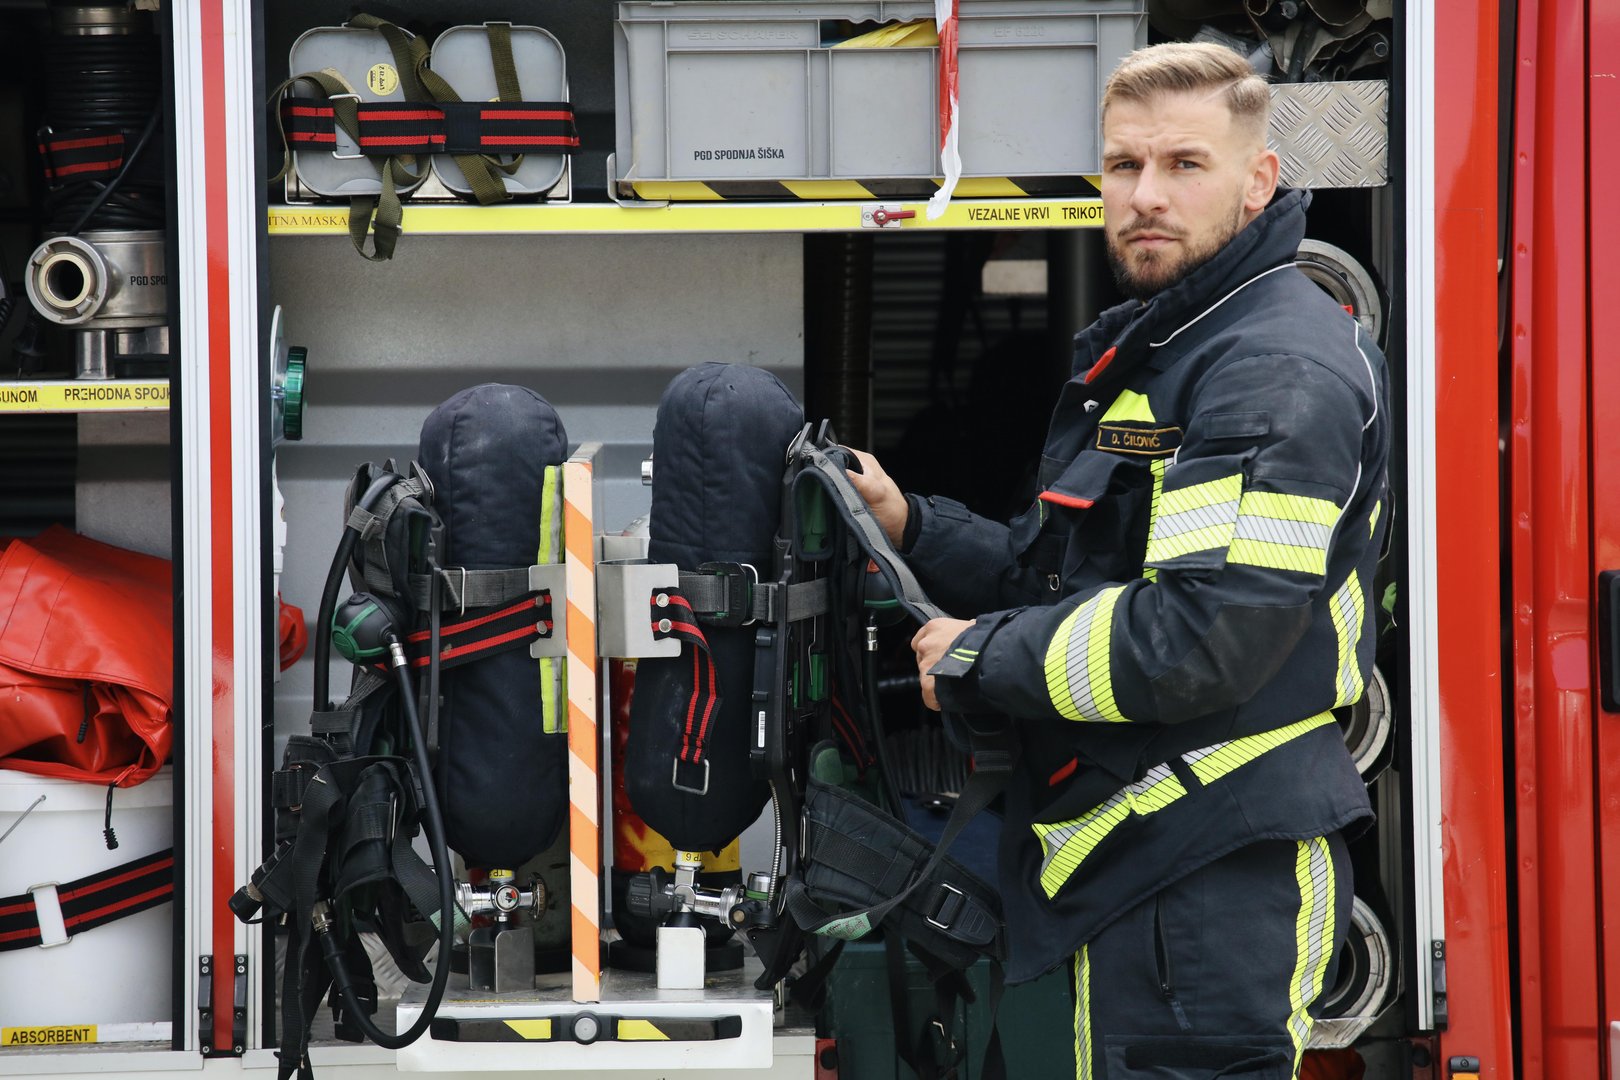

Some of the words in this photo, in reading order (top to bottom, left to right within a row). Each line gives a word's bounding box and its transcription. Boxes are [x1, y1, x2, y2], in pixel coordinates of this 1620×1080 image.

[694, 150, 712, 161] PGD
[714, 149, 756, 160] SPODNJA
[757, 147, 785, 159] ŠIŠKA
[301, 216, 347, 226] MASKA
[968, 208, 1021, 221] VEZALNE
[1023, 207, 1050, 220] VRVI
[1062, 206, 1104, 220] TRIKOT
[130, 275, 149, 286] PGD
[0, 389, 38, 403] UNOM
[64, 387, 132, 401] PREHODNA
[1112, 433, 1120, 445] D.
[1123, 432, 1161, 448] ČILOVIĆ
[10, 1028, 90, 1044] ABSORBENT
